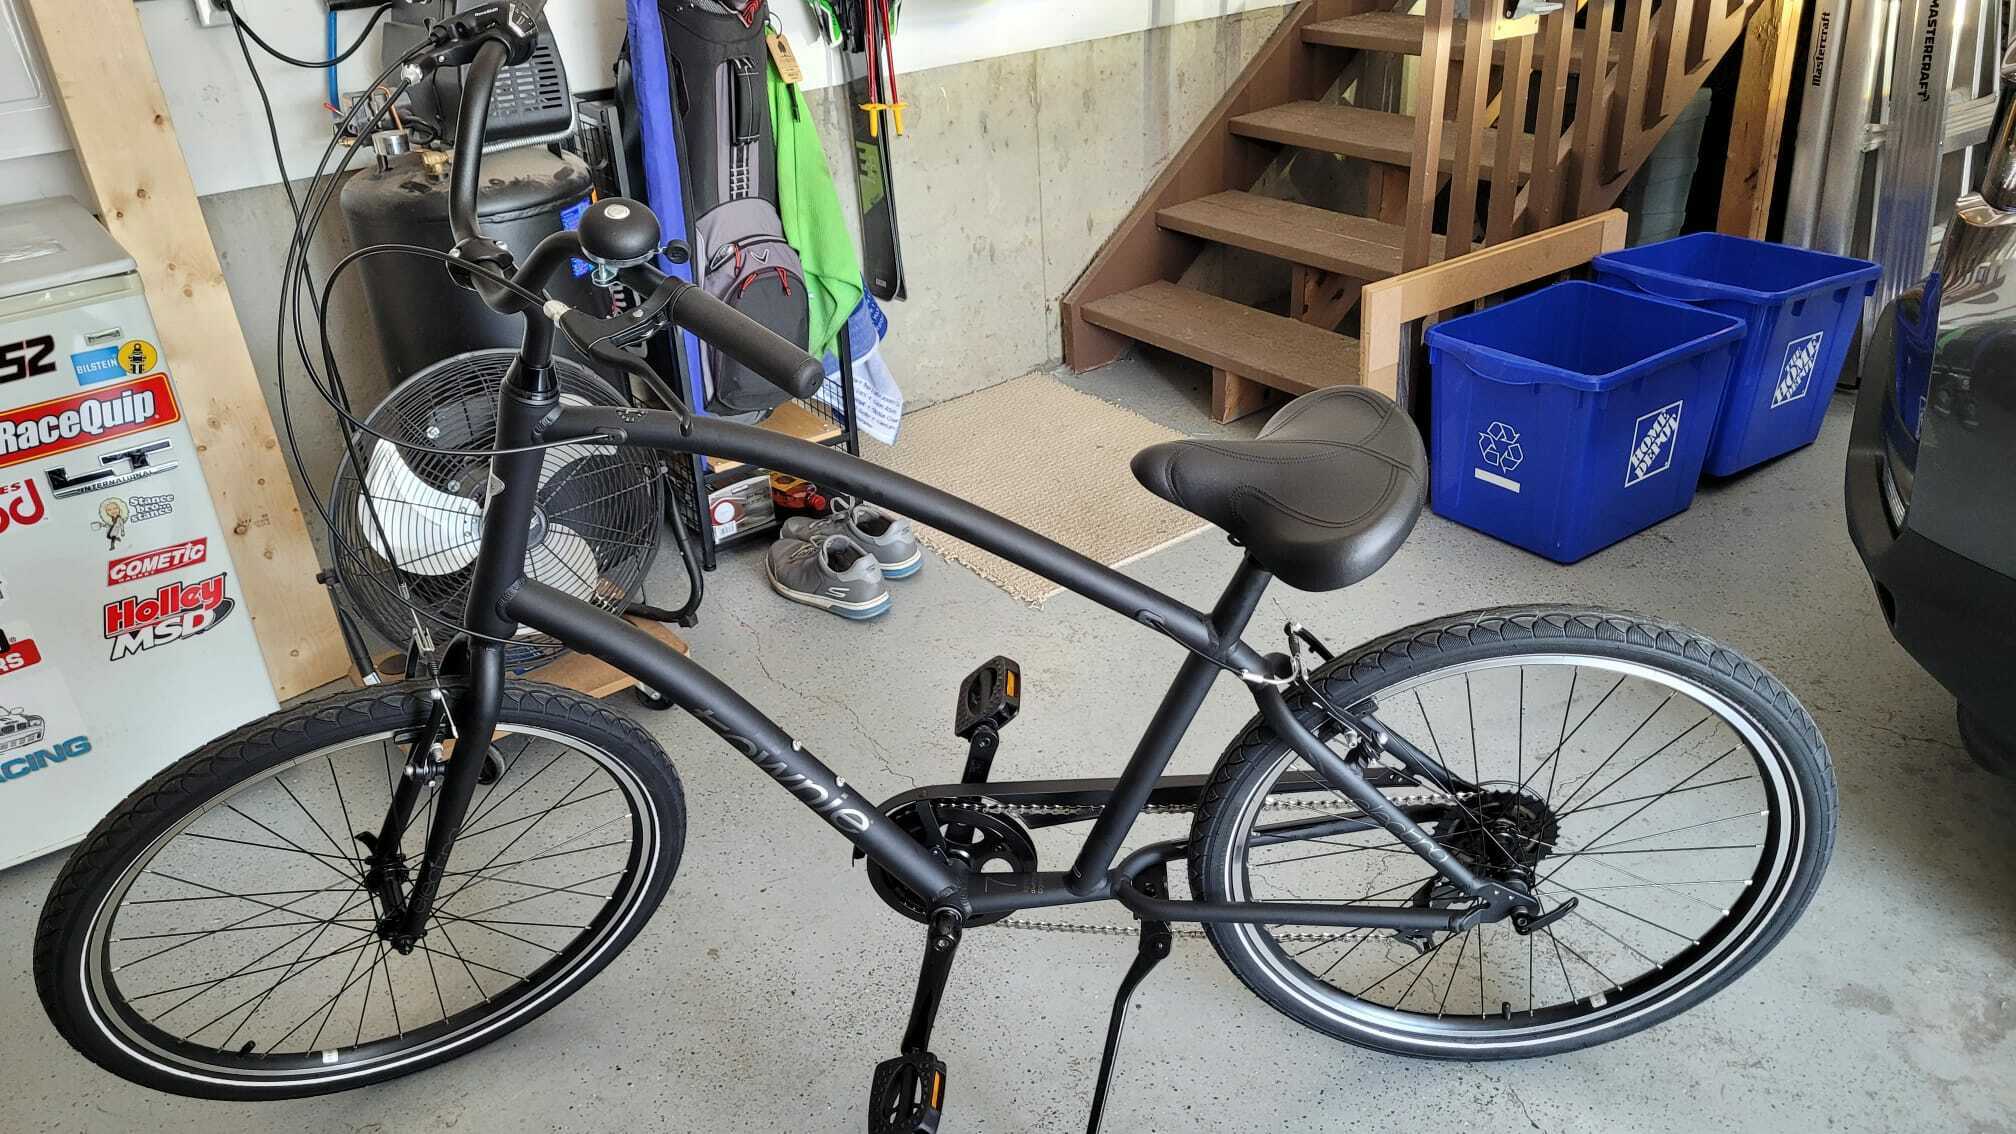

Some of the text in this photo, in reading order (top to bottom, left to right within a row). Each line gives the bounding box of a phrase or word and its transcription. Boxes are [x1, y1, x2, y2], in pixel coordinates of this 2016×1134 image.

[1811, 11, 1831, 87] Mastercraft
[1916, 0, 1940, 101] MASTERCRAFT
[76, 357, 119, 376] BILSTEIN
[1775, 335, 1818, 402] HOME
[0, 388, 156, 456] RaceQuip
[1630, 408, 1670, 469] HOME
[1634, 413, 1678, 480] DEPOT
[129, 494, 174, 507] Stance
[130, 508, 173, 523] stance
[110, 543, 206, 580] COMETIC
[104, 572, 227, 638] Holley
[110, 611, 216, 662] MSD
[0, 735, 93, 784] CING
[692, 708, 870, 834] townie
